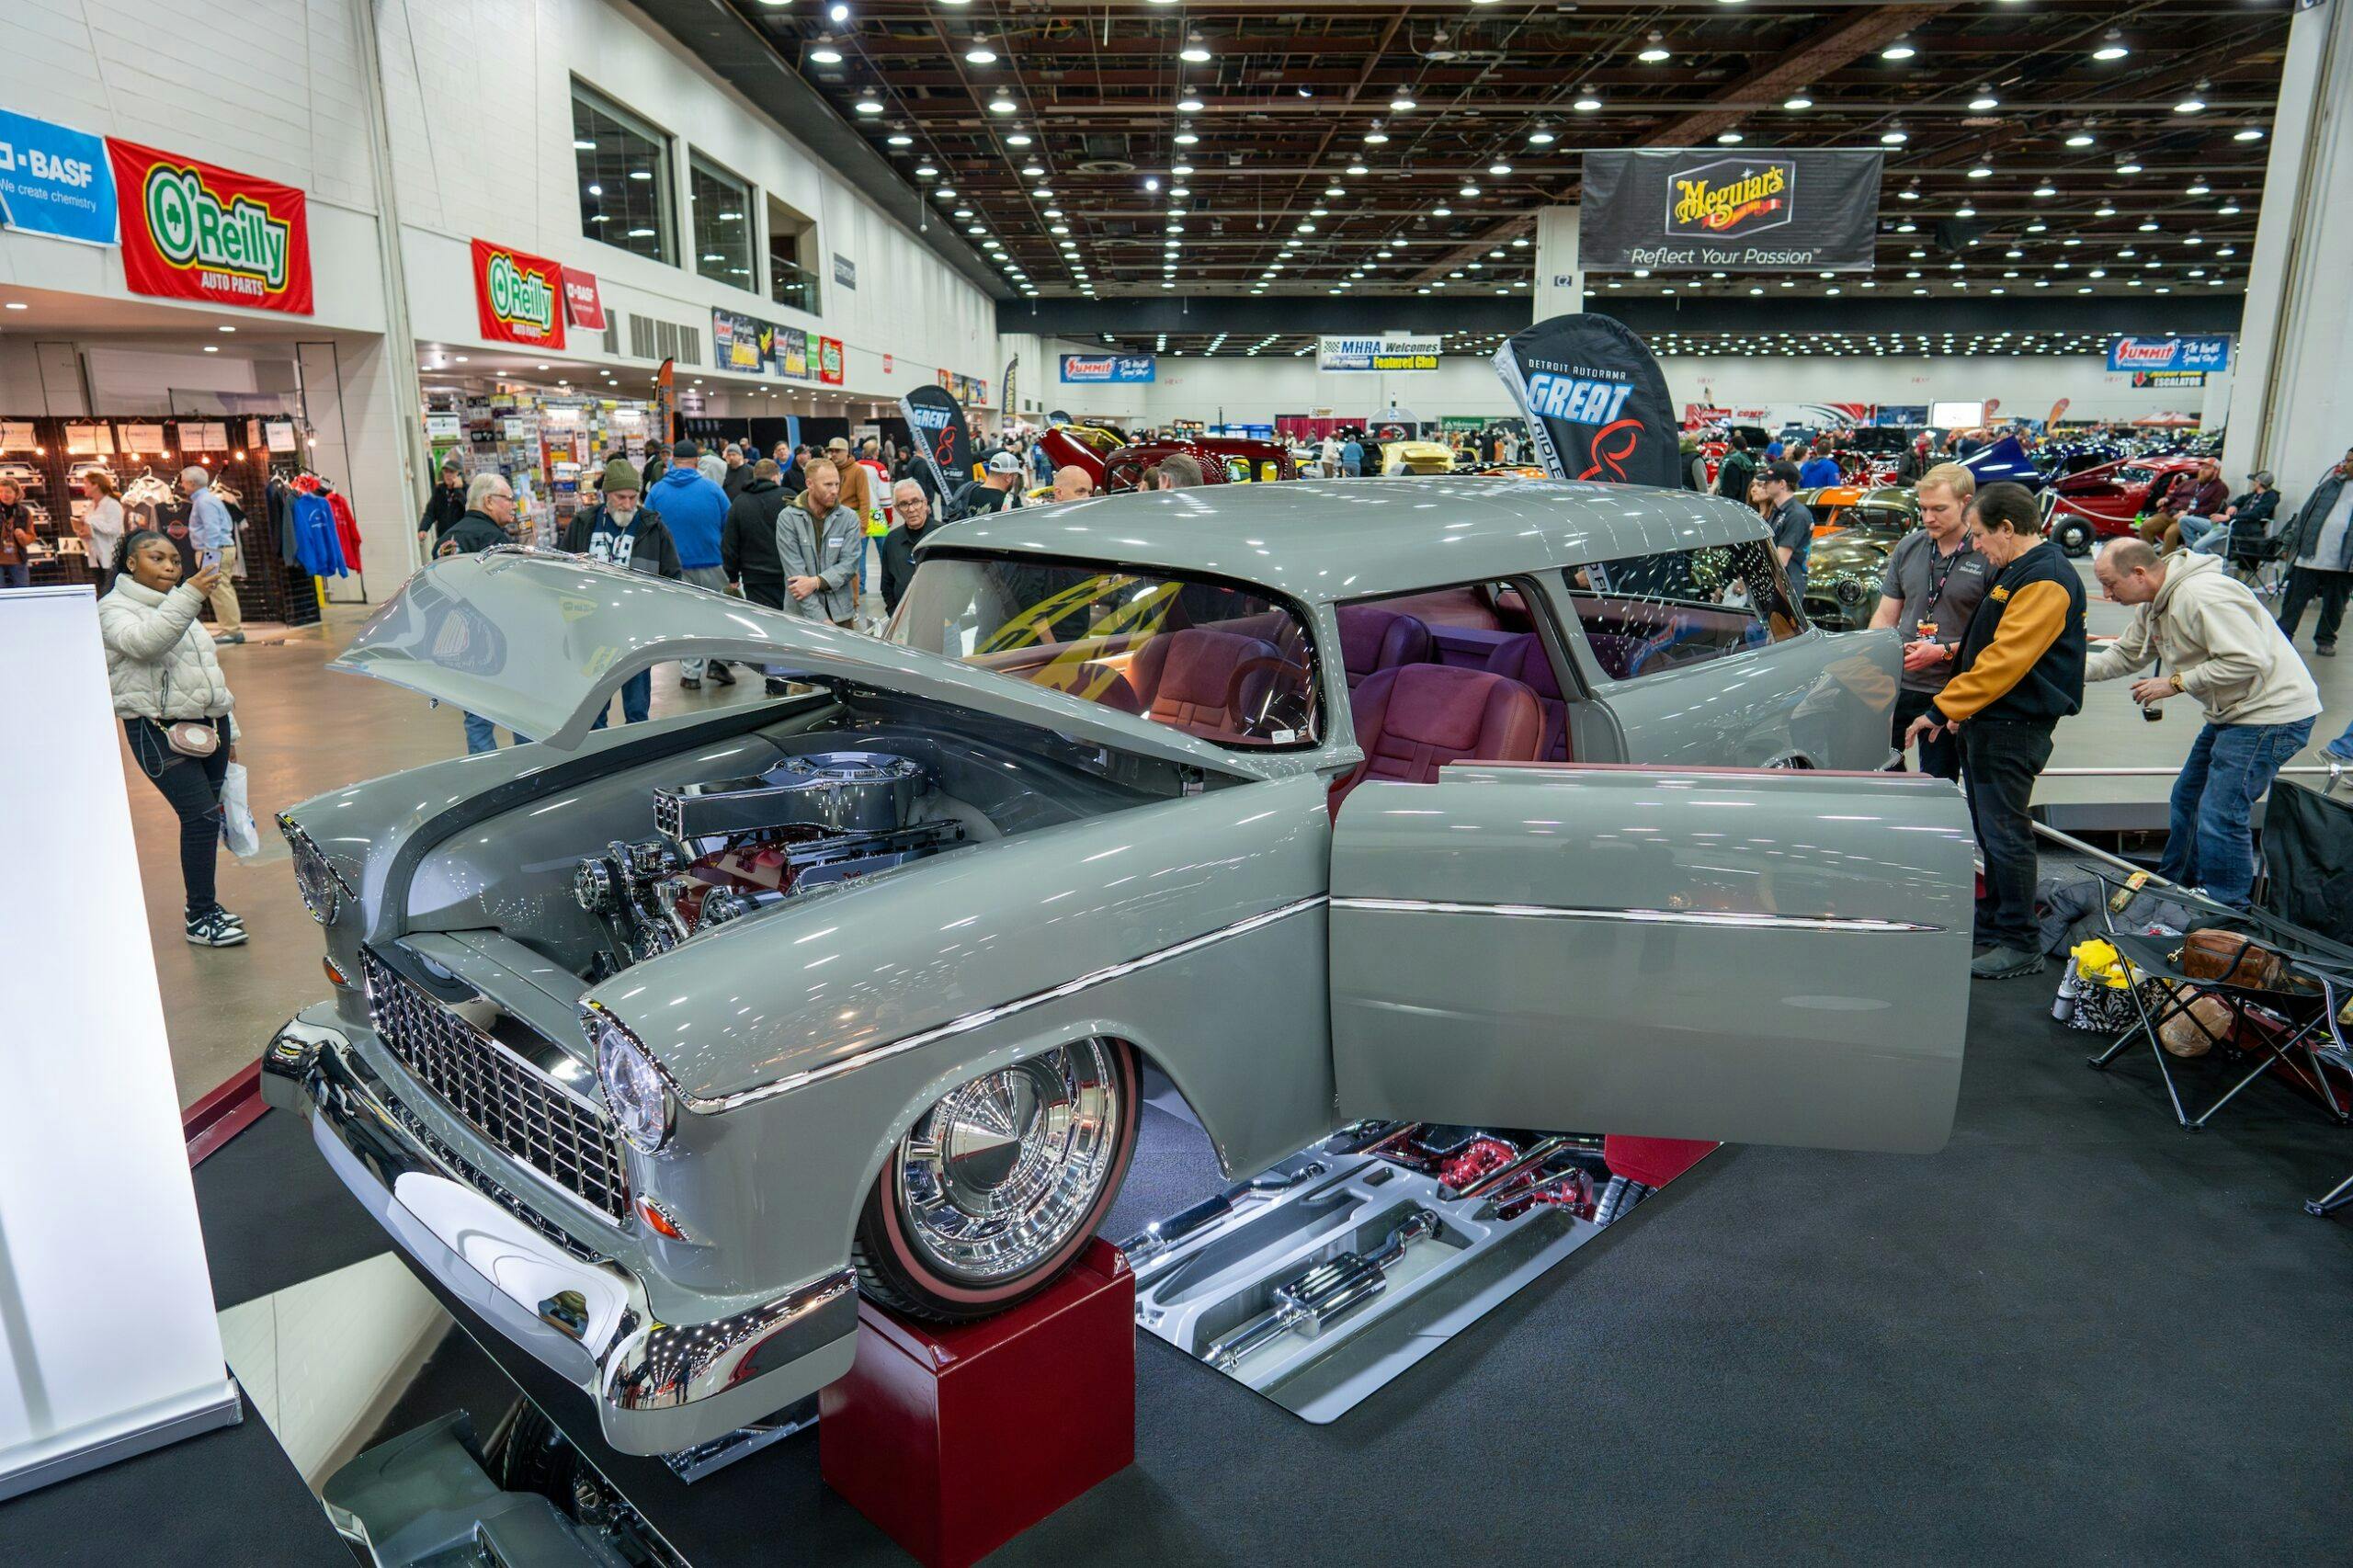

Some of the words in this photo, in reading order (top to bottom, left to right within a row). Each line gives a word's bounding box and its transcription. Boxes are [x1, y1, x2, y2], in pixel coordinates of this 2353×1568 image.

[28, 149, 93, 188] BASF
[18, 184, 49, 199] create
[51, 190, 97, 213] chemistry
[1674, 165, 1785, 228] Meguiar's
[150, 171, 286, 284] O'Reilly
[1631, 247, 1695, 267] Reflect
[1701, 248, 1740, 264] Your
[201, 271, 230, 291] AUTO
[231, 275, 265, 296] PARTS
[492, 257, 551, 330] O'Reilly
[1341, 341, 1381, 354] MHRA
[1385, 342, 1438, 354] Welcomes
[1372, 355, 1415, 369] Featured
[1415, 354, 1438, 369] Club
[1529, 358, 1569, 372] DETROIT
[1573, 366, 1627, 381] AUTORAMA
[1528, 373, 1634, 426] GREAT
[915, 409, 952, 429] GREAT
[1533, 422, 1563, 479] RIDLE
